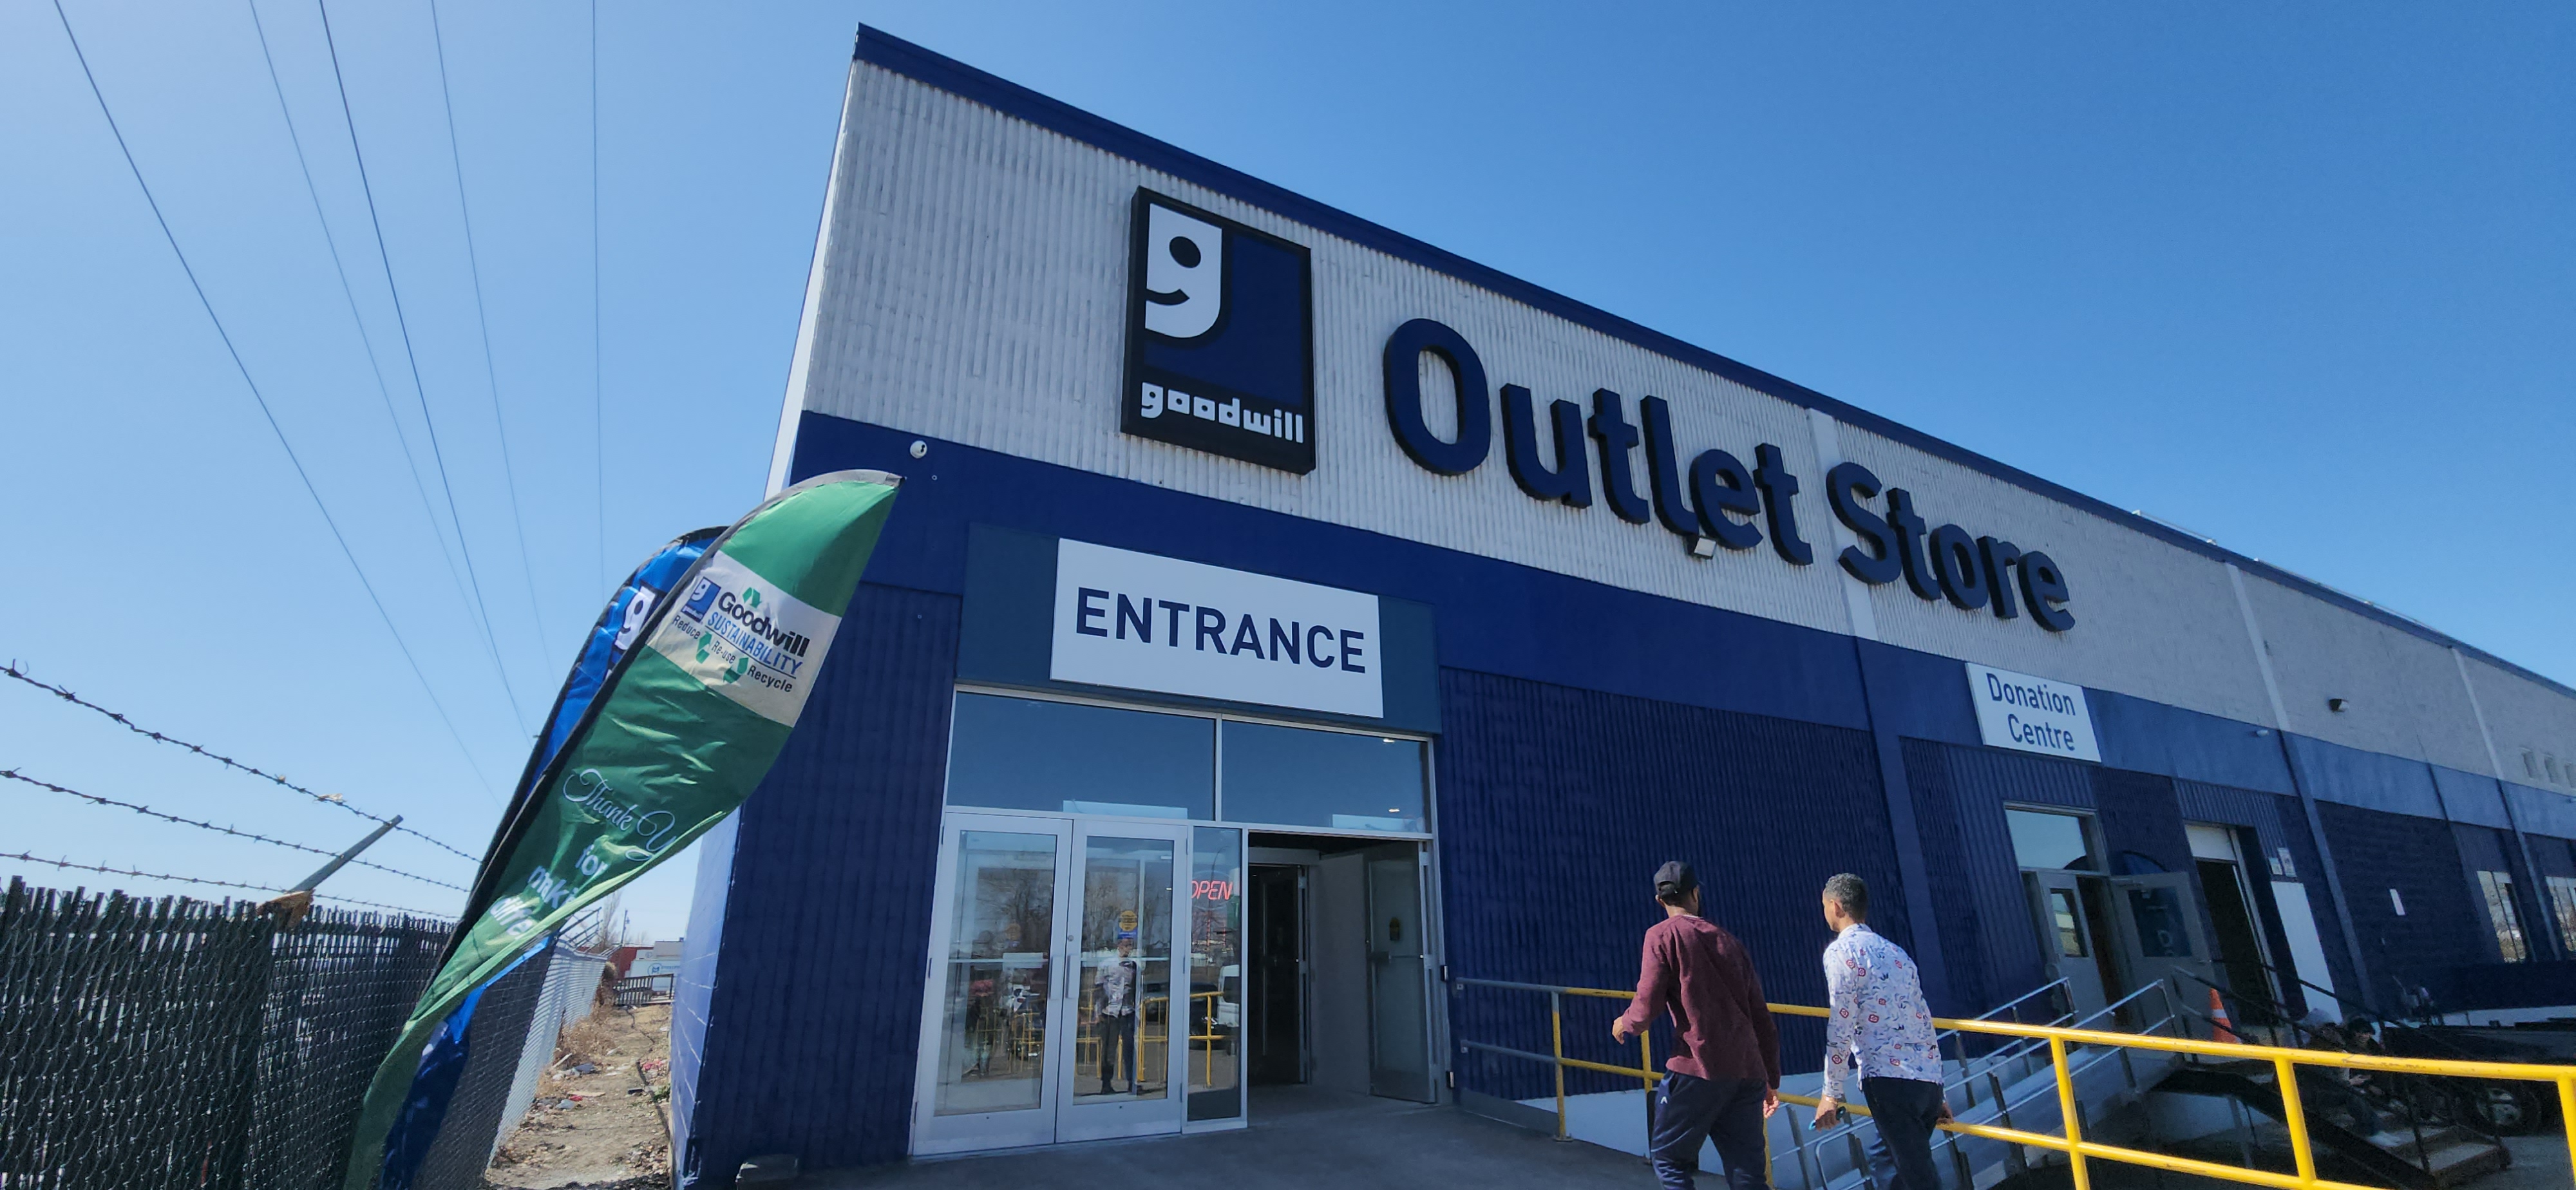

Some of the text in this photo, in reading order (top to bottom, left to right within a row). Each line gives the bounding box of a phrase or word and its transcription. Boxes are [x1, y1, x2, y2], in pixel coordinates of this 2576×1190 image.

[1141, 382, 1304, 443] goodwill
[1383, 317, 2076, 632] Outlet Store
[672, 614, 701, 639] Reduce
[708, 612, 803, 675] SUSTAINABILITY
[712, 641, 736, 664] Re-use
[718, 592, 810, 657] Goodwill
[1076, 587, 1366, 674] ENTRANCE
[747, 665, 793, 693] Recycle
[1986, 673, 2076, 715] Donation
[2007, 713, 2076, 751] Centre
[563, 768, 638, 831] Thank
